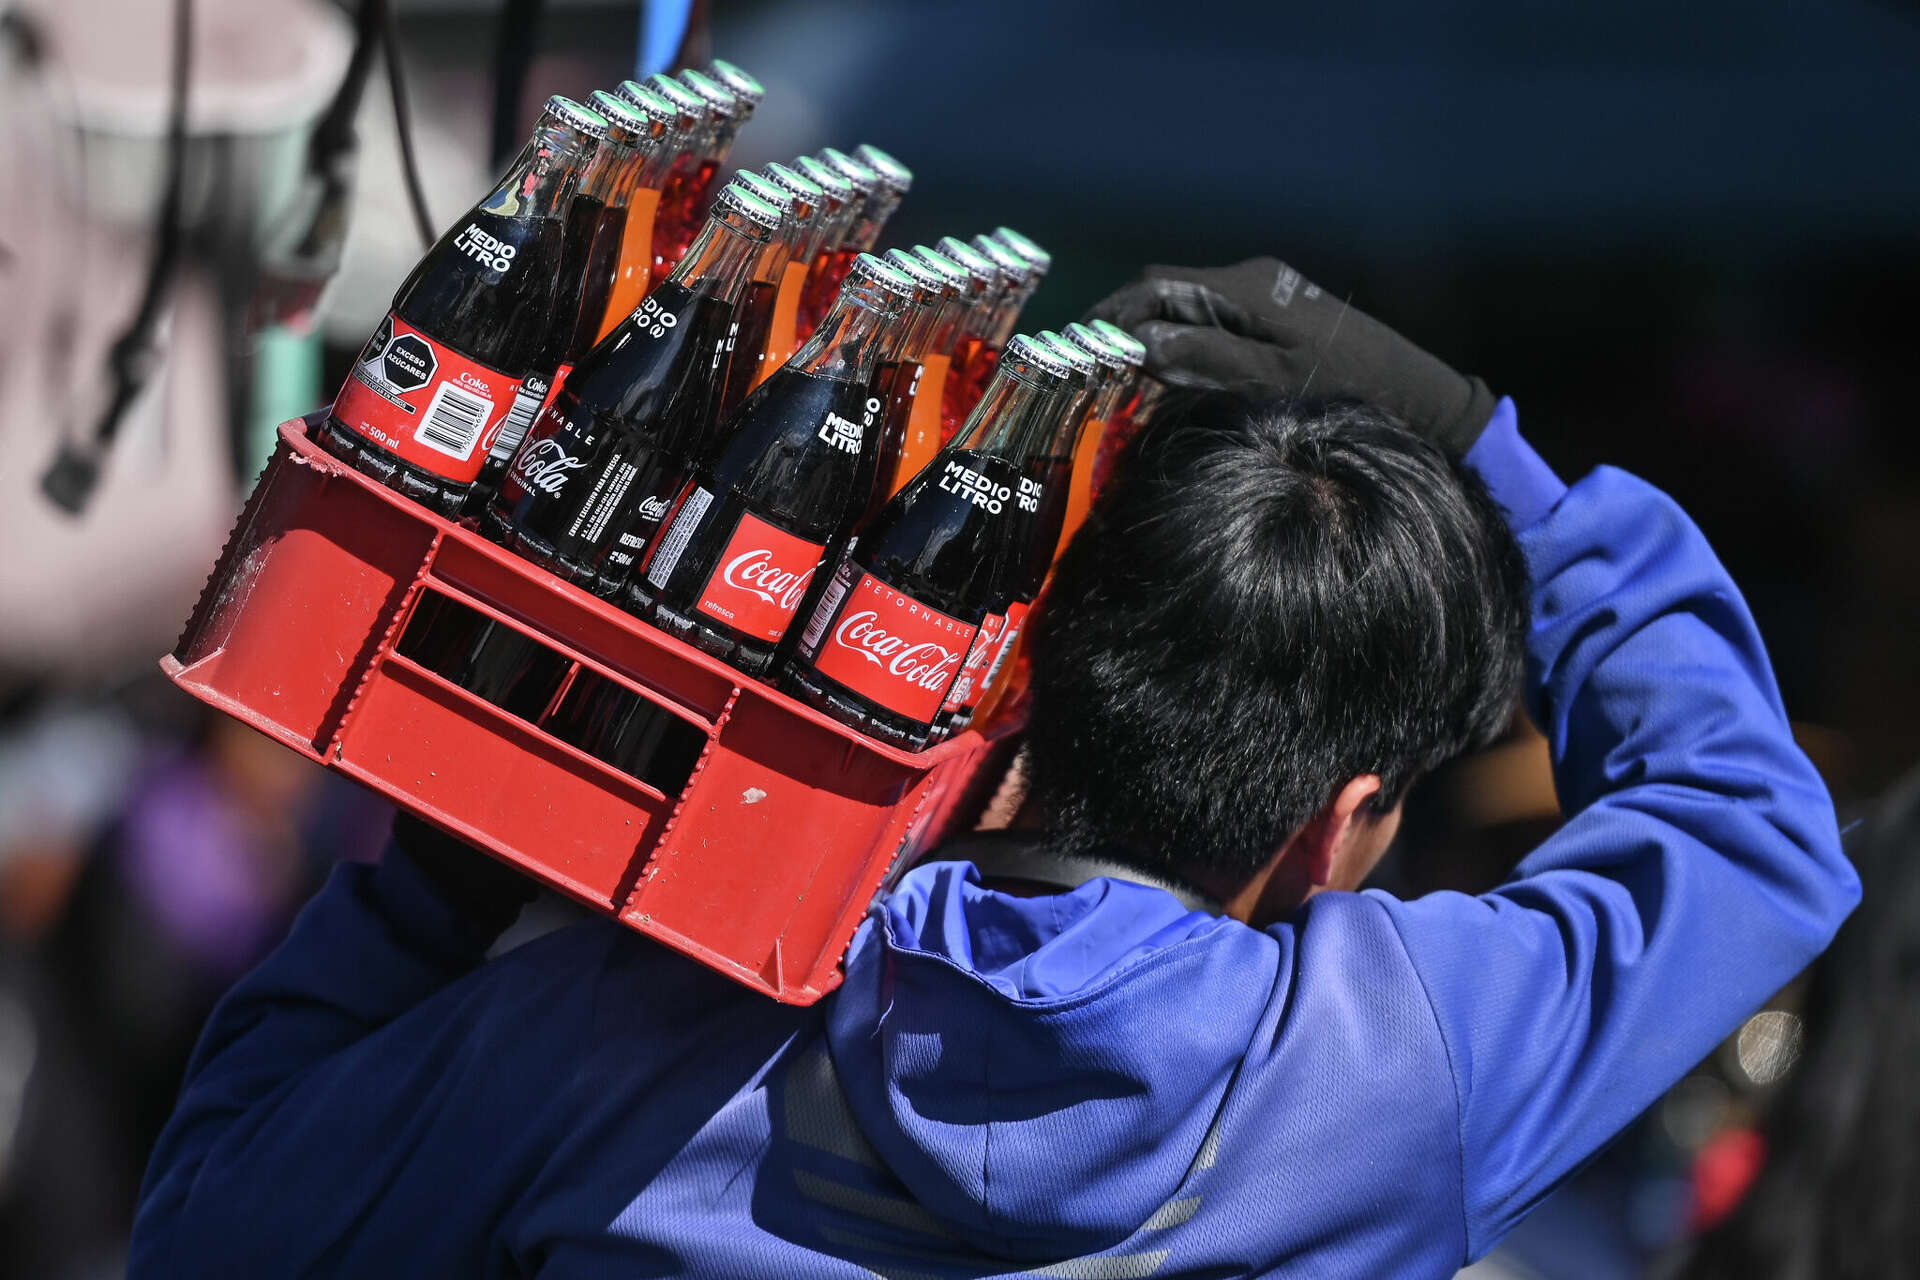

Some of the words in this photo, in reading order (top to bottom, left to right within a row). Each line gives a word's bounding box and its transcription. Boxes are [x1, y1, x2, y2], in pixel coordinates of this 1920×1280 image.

[453, 234, 511, 273] LITRO
[463, 223, 517, 260] MEDIO
[386, 353, 427, 380] AZÚCARES
[396, 346, 426, 368] EXCESO
[460, 372, 489, 391] Coke
[370, 426, 387, 443] 500
[386, 437, 400, 449] ml
[550, 408, 595, 446] NABLE
[818, 424, 862, 455] LITRO
[825, 411, 864, 440] MEDIO
[579, 491, 598, 518] EXCLUSIVO
[594, 478, 606, 492] PARA
[602, 454, 622, 479] REFRESCO.
[938, 475, 1002, 515] LITRO
[944, 460, 1011, 501] MEDIO
[1019, 476, 1043, 499] DIO
[704, 599, 735, 620] refresco
[864, 579, 971, 639] RETORNABLE
[835, 610, 961, 692] Coca-Cola
